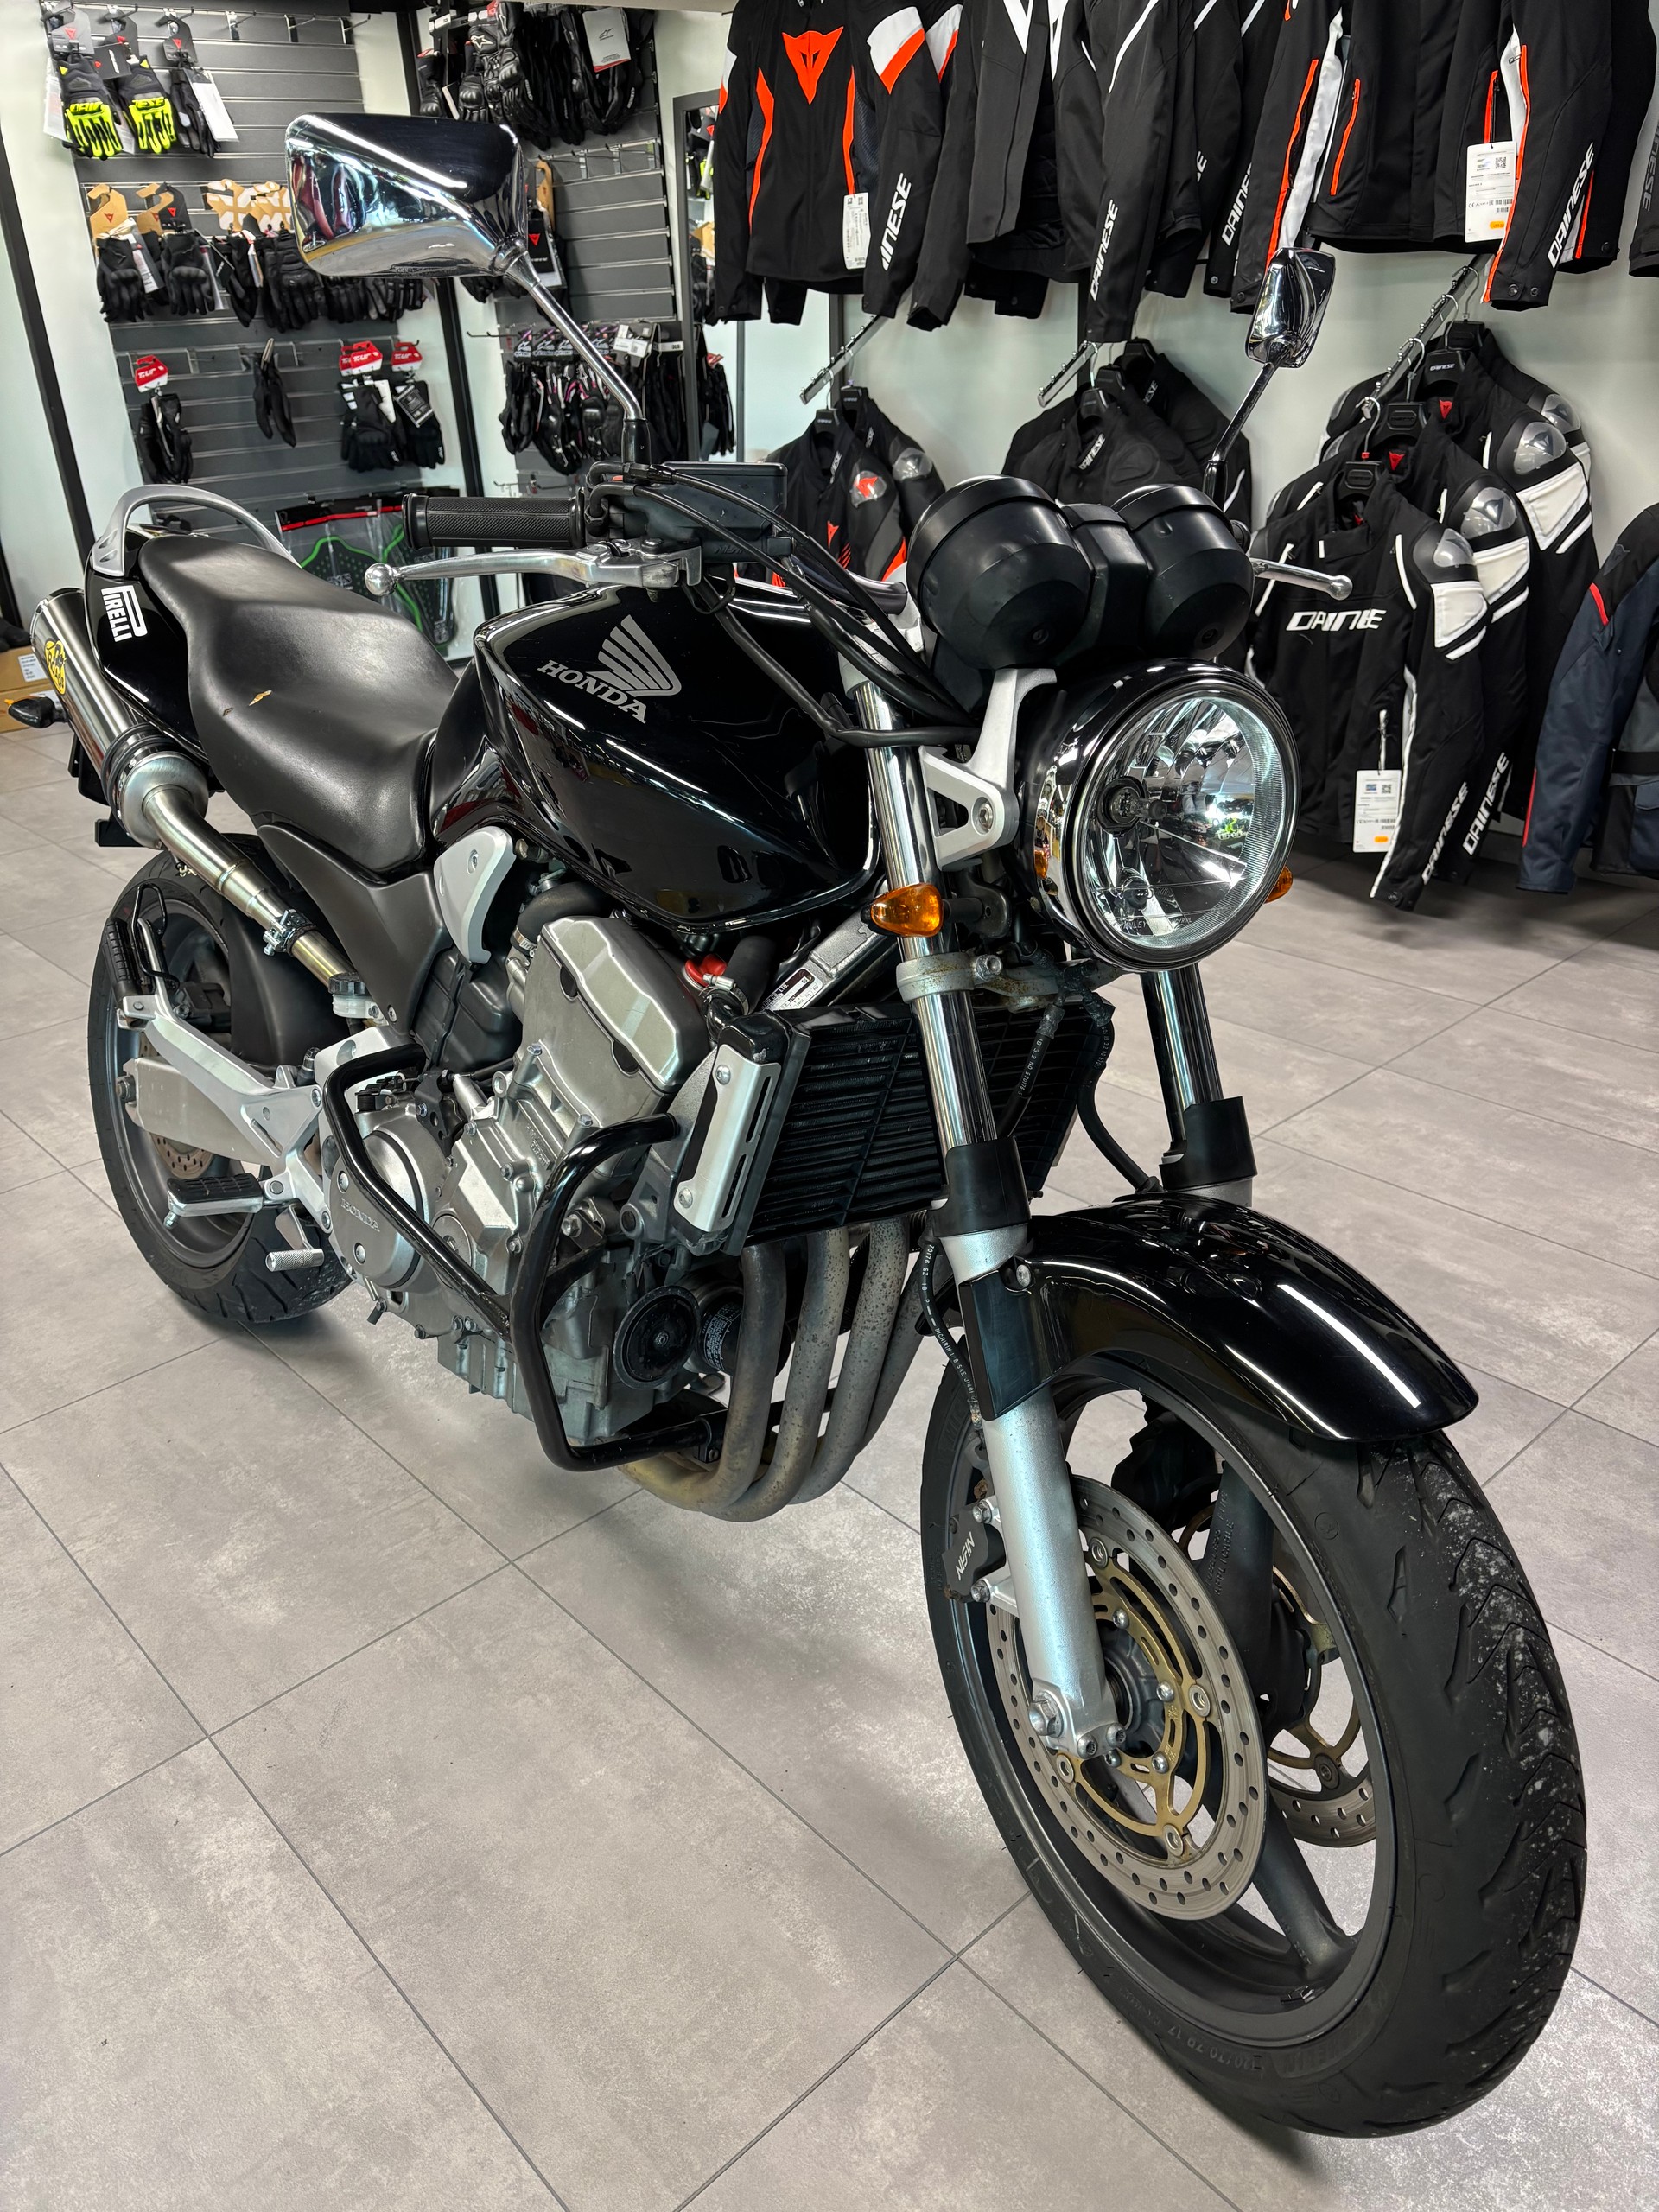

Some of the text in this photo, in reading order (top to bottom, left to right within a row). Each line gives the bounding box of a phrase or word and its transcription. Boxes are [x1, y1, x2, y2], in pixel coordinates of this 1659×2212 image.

[1547, 141, 1594, 269] DAINESE
[1090, 199, 1119, 302] DAINESE
[101, 585, 148, 642] PIRELLI
[537, 659, 647, 724] HONDA
[1421, 781, 1469, 885] DAINESE
[1461, 752, 1510, 855] DAINESE
[340, 1198, 380, 1233] HONDA
[934, 1327, 951, 1352] NICHIRIN
[957, 1363, 967, 1376] SAE
[955, 1530, 976, 1581] NISSIN
